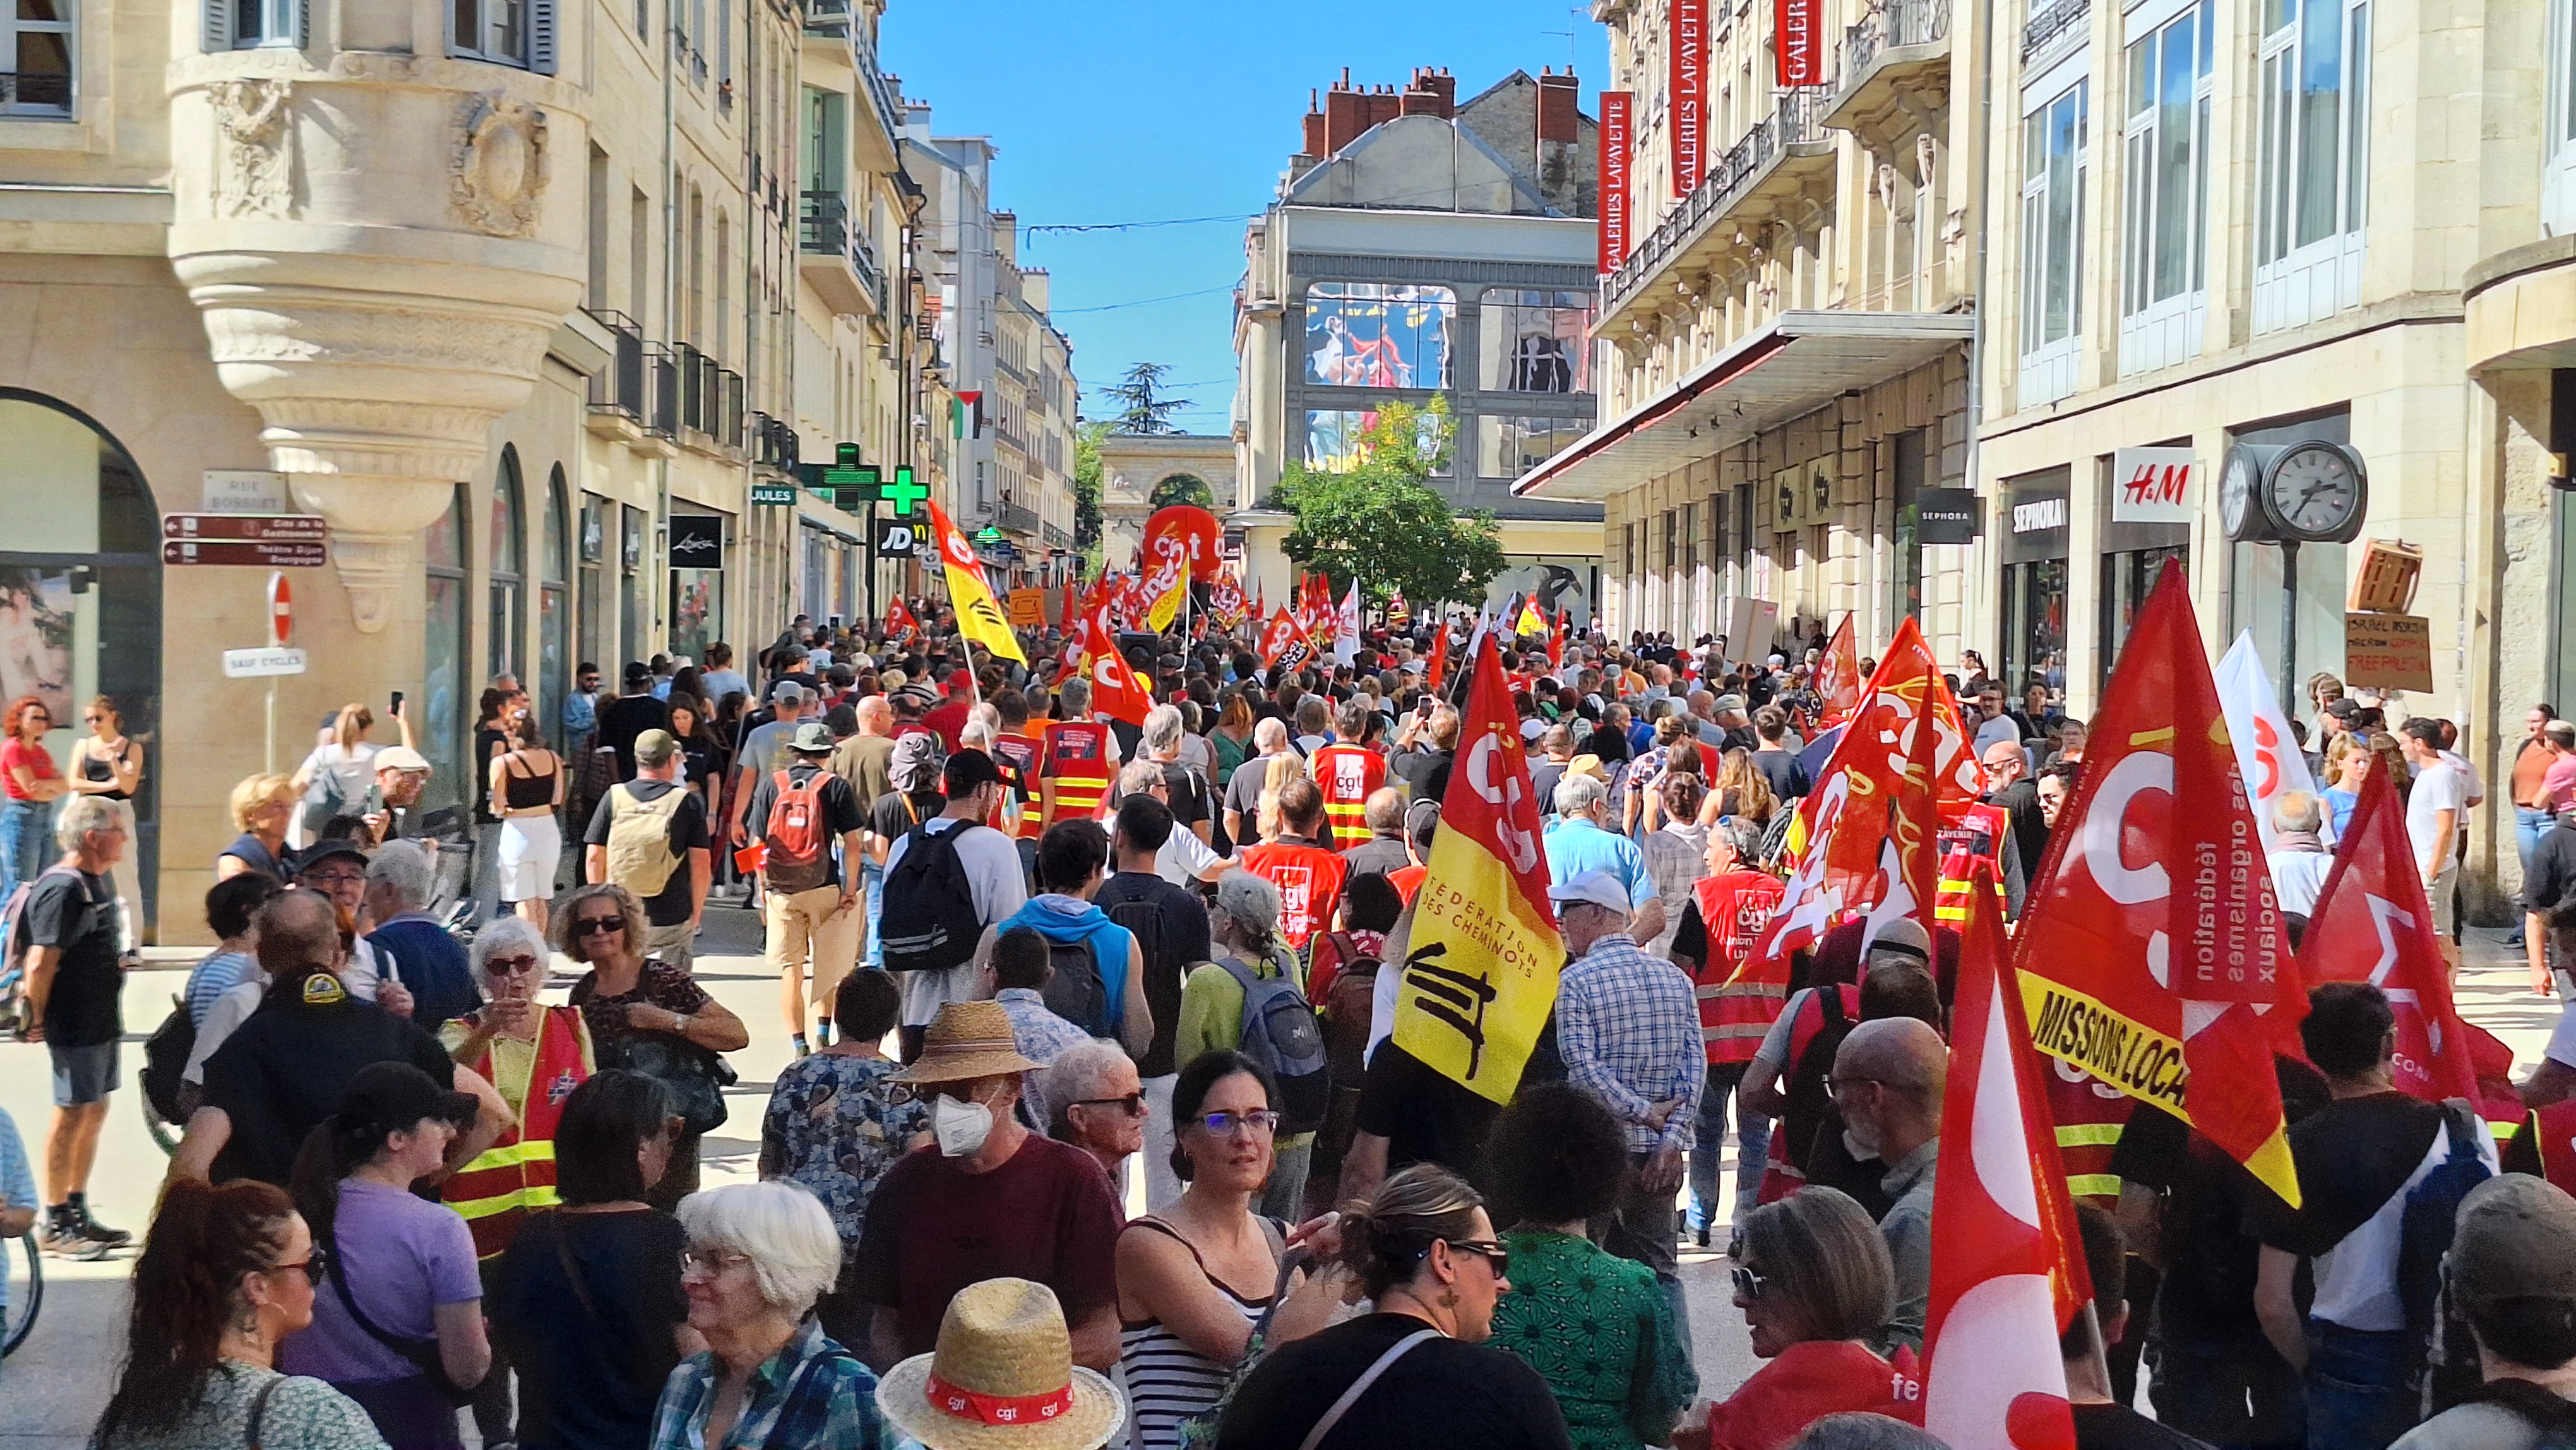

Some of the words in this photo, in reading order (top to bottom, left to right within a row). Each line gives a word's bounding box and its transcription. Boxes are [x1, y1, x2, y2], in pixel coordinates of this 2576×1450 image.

[1608, 100, 1623, 188] LAFAYETTE
[1680, 100, 1697, 192] GALERIES
[1607, 193, 1622, 270] GALERIES
[751, 490, 790, 501] JULES
[2124, 463, 2190, 506] H&M
[1922, 511, 1969, 520] SEPHORA
[2013, 498, 2066, 534] SEPHORA
[881, 527, 912, 550] JD
[2347, 618, 2389, 632] ISRAEL
[1452, 914, 1533, 978] CHEMINOTS
[948, 1396, 967, 1411] cgt
[996, 1406, 1018, 1421] cgt
[1041, 1401, 1059, 1417] cgt
